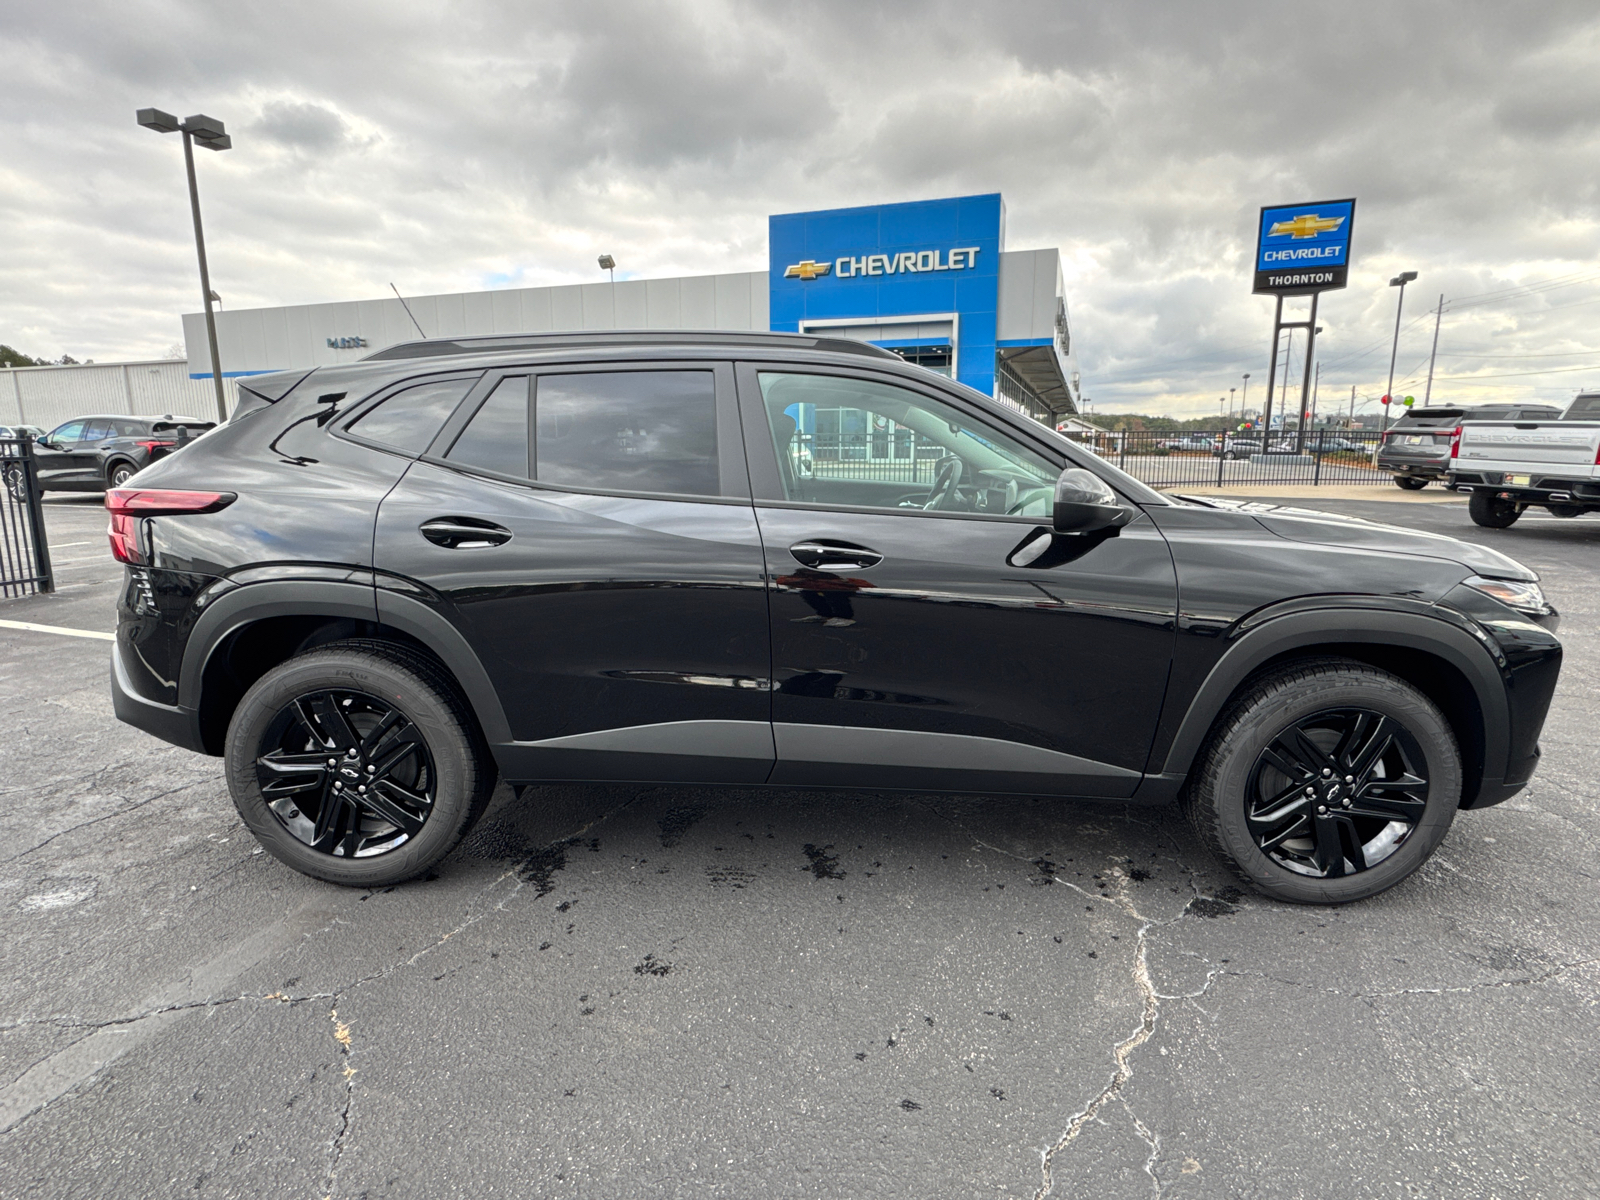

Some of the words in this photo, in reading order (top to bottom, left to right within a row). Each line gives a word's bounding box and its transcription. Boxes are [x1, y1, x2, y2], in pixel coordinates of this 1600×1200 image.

[1264, 246, 1342, 261] CHEVROLET
[836, 247, 980, 277] CHEVROLET
[1268, 273, 1333, 285] THORNTON
